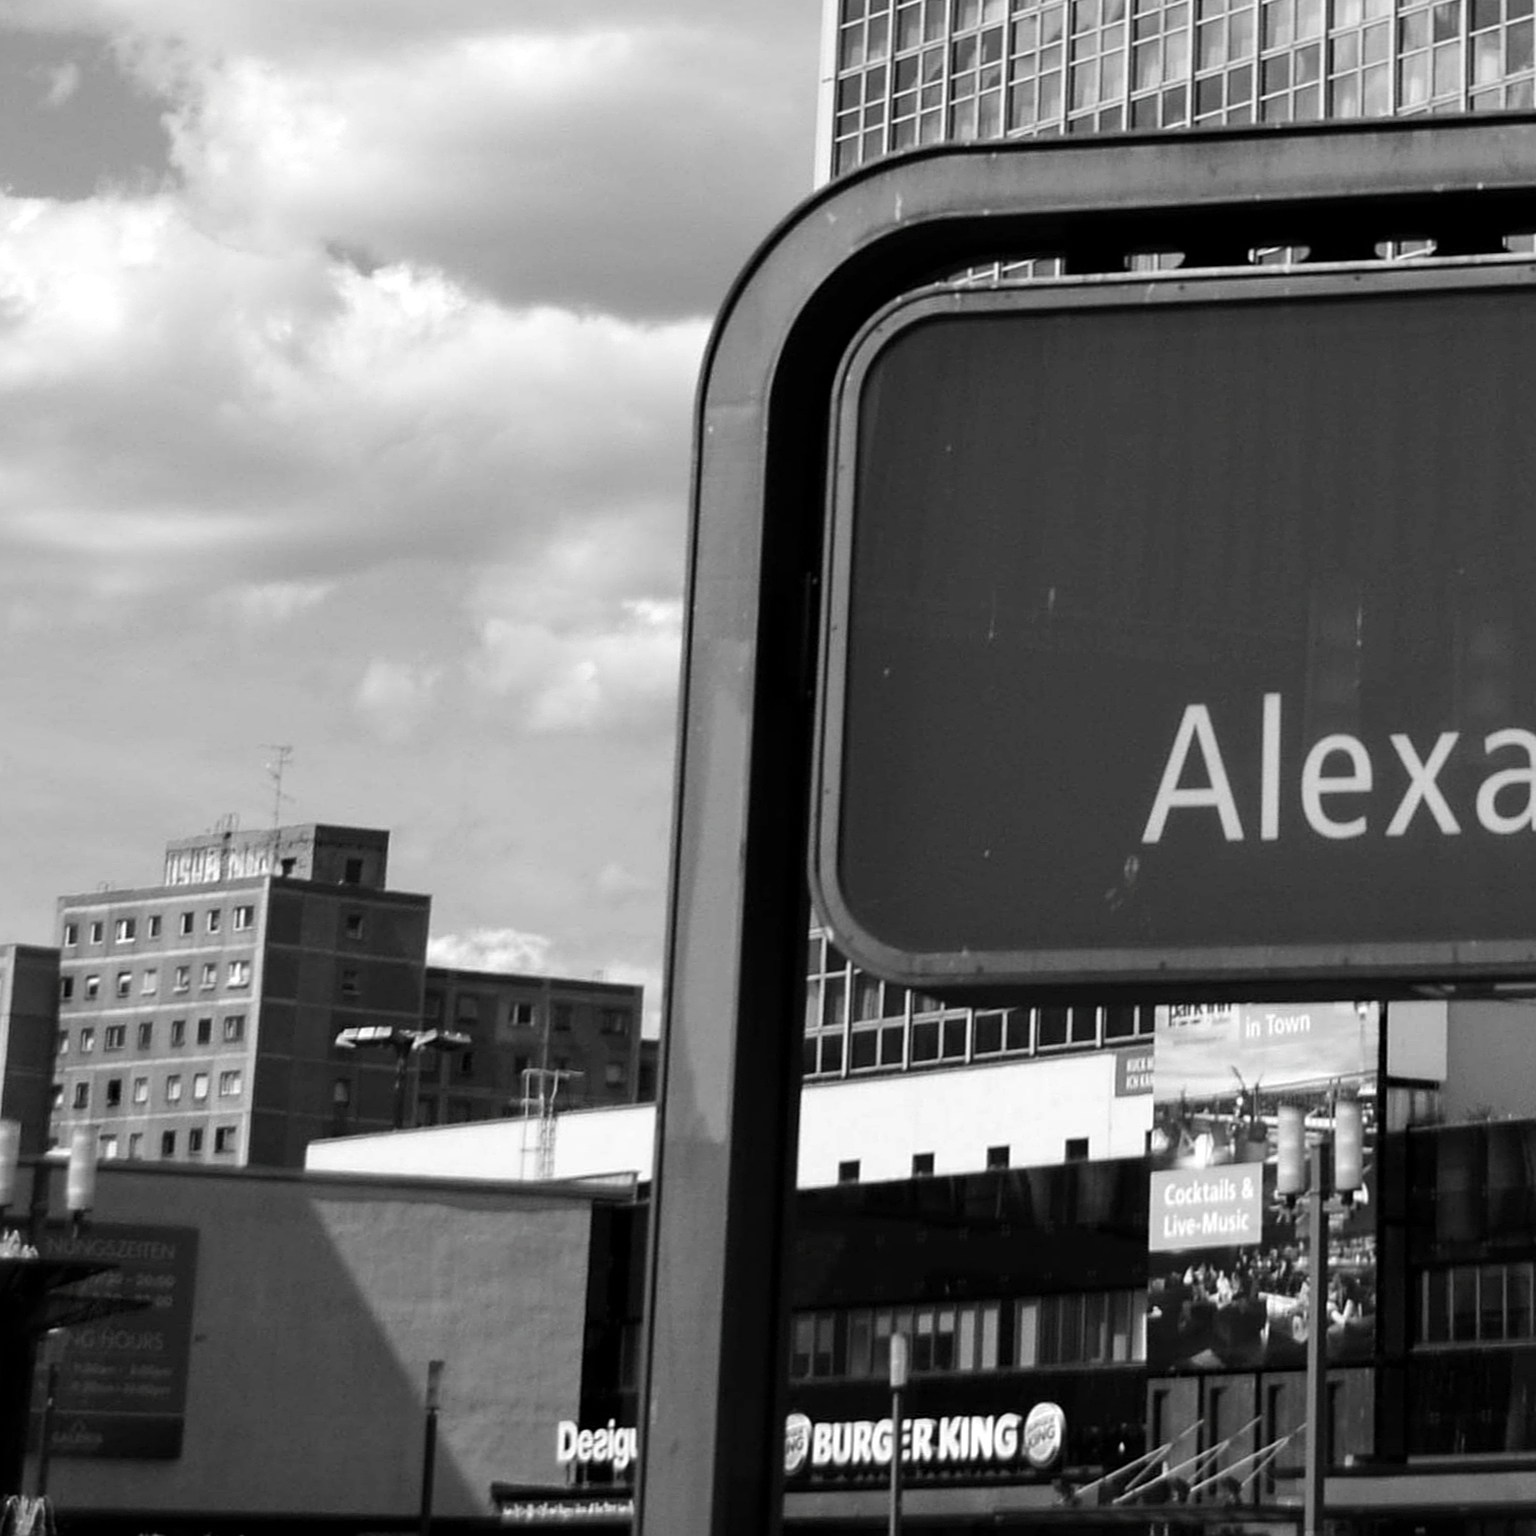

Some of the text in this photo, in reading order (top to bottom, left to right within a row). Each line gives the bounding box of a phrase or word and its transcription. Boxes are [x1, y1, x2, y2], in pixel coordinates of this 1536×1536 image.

[1245, 1013, 1311, 1038] in Town
[1164, 1176, 1255, 1206] Cocktails &
[1163, 1209, 1250, 1238] Live-Music
[812, 1412, 1023, 1466] BURGER KING
